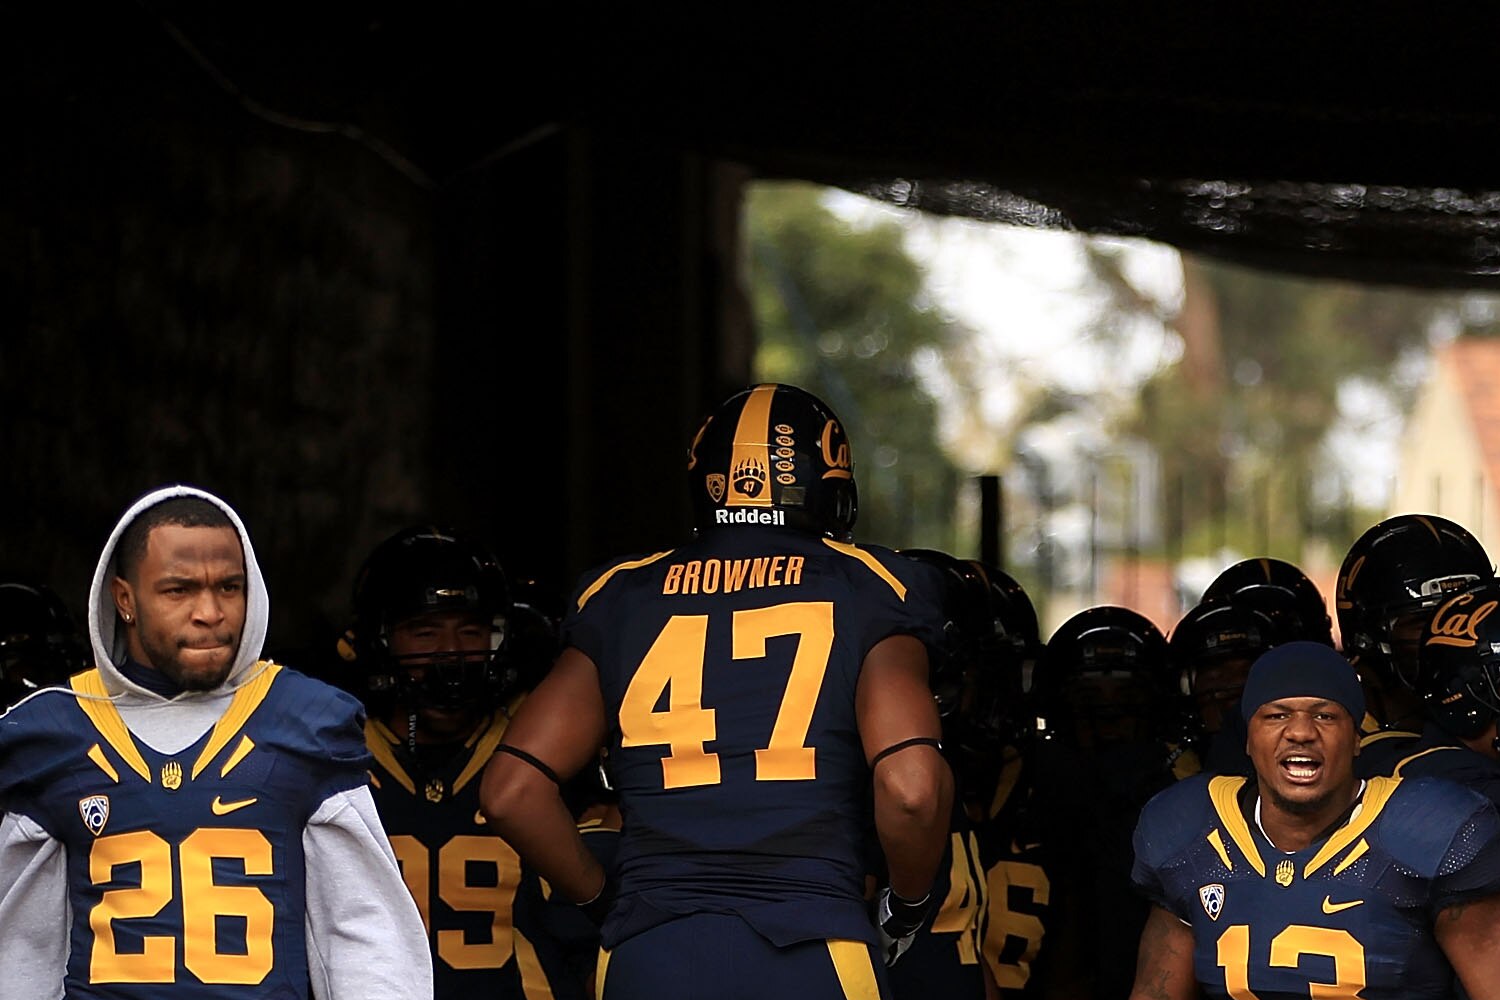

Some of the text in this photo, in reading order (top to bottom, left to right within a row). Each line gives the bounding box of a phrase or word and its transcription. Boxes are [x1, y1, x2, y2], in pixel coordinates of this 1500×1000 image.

[821, 419, 850, 479] Ca
[742, 481, 755, 493] 47
[715, 508, 785, 526] Riddell
[662, 556, 805, 595] BROWNER
[1425, 593, 1499, 648] Cal
[619, 602, 835, 789] 47
[89, 813, 104, 829] 10
[89, 828, 274, 985] 26
[1208, 899, 1220, 913] 10
